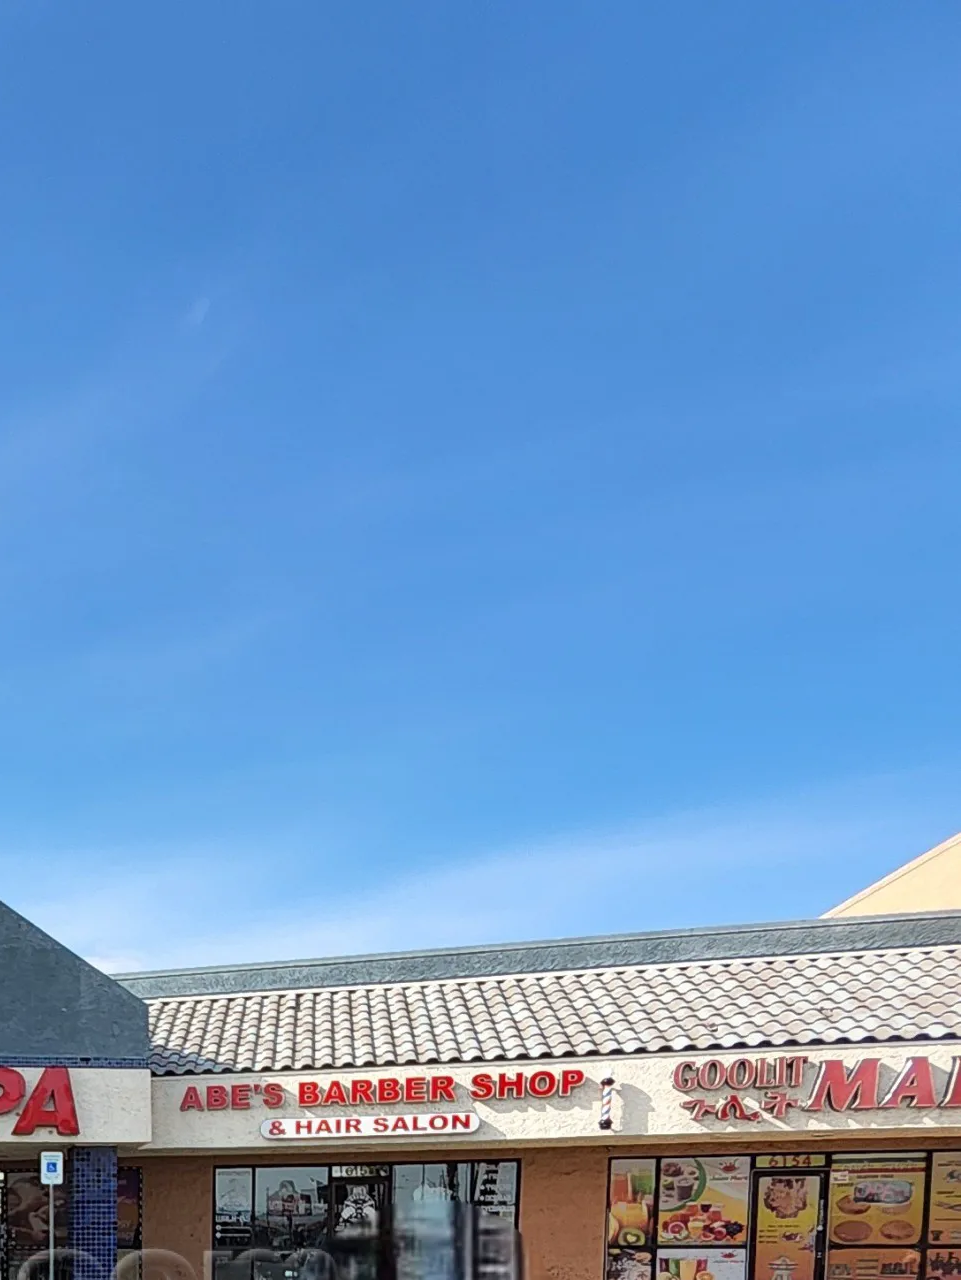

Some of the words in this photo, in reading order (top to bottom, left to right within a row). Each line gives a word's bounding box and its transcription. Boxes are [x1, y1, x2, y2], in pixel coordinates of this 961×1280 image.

[180, 1083, 284, 1112] ABE'S
[298, 1075, 455, 1107] BARBER
[470, 1070, 584, 1100] SHOP
[673, 1057, 808, 1091] GOOLIT
[268, 1121, 286, 1136] &
[294, 1117, 362, 1135] HAIR
[373, 1113, 471, 1133] SALON
